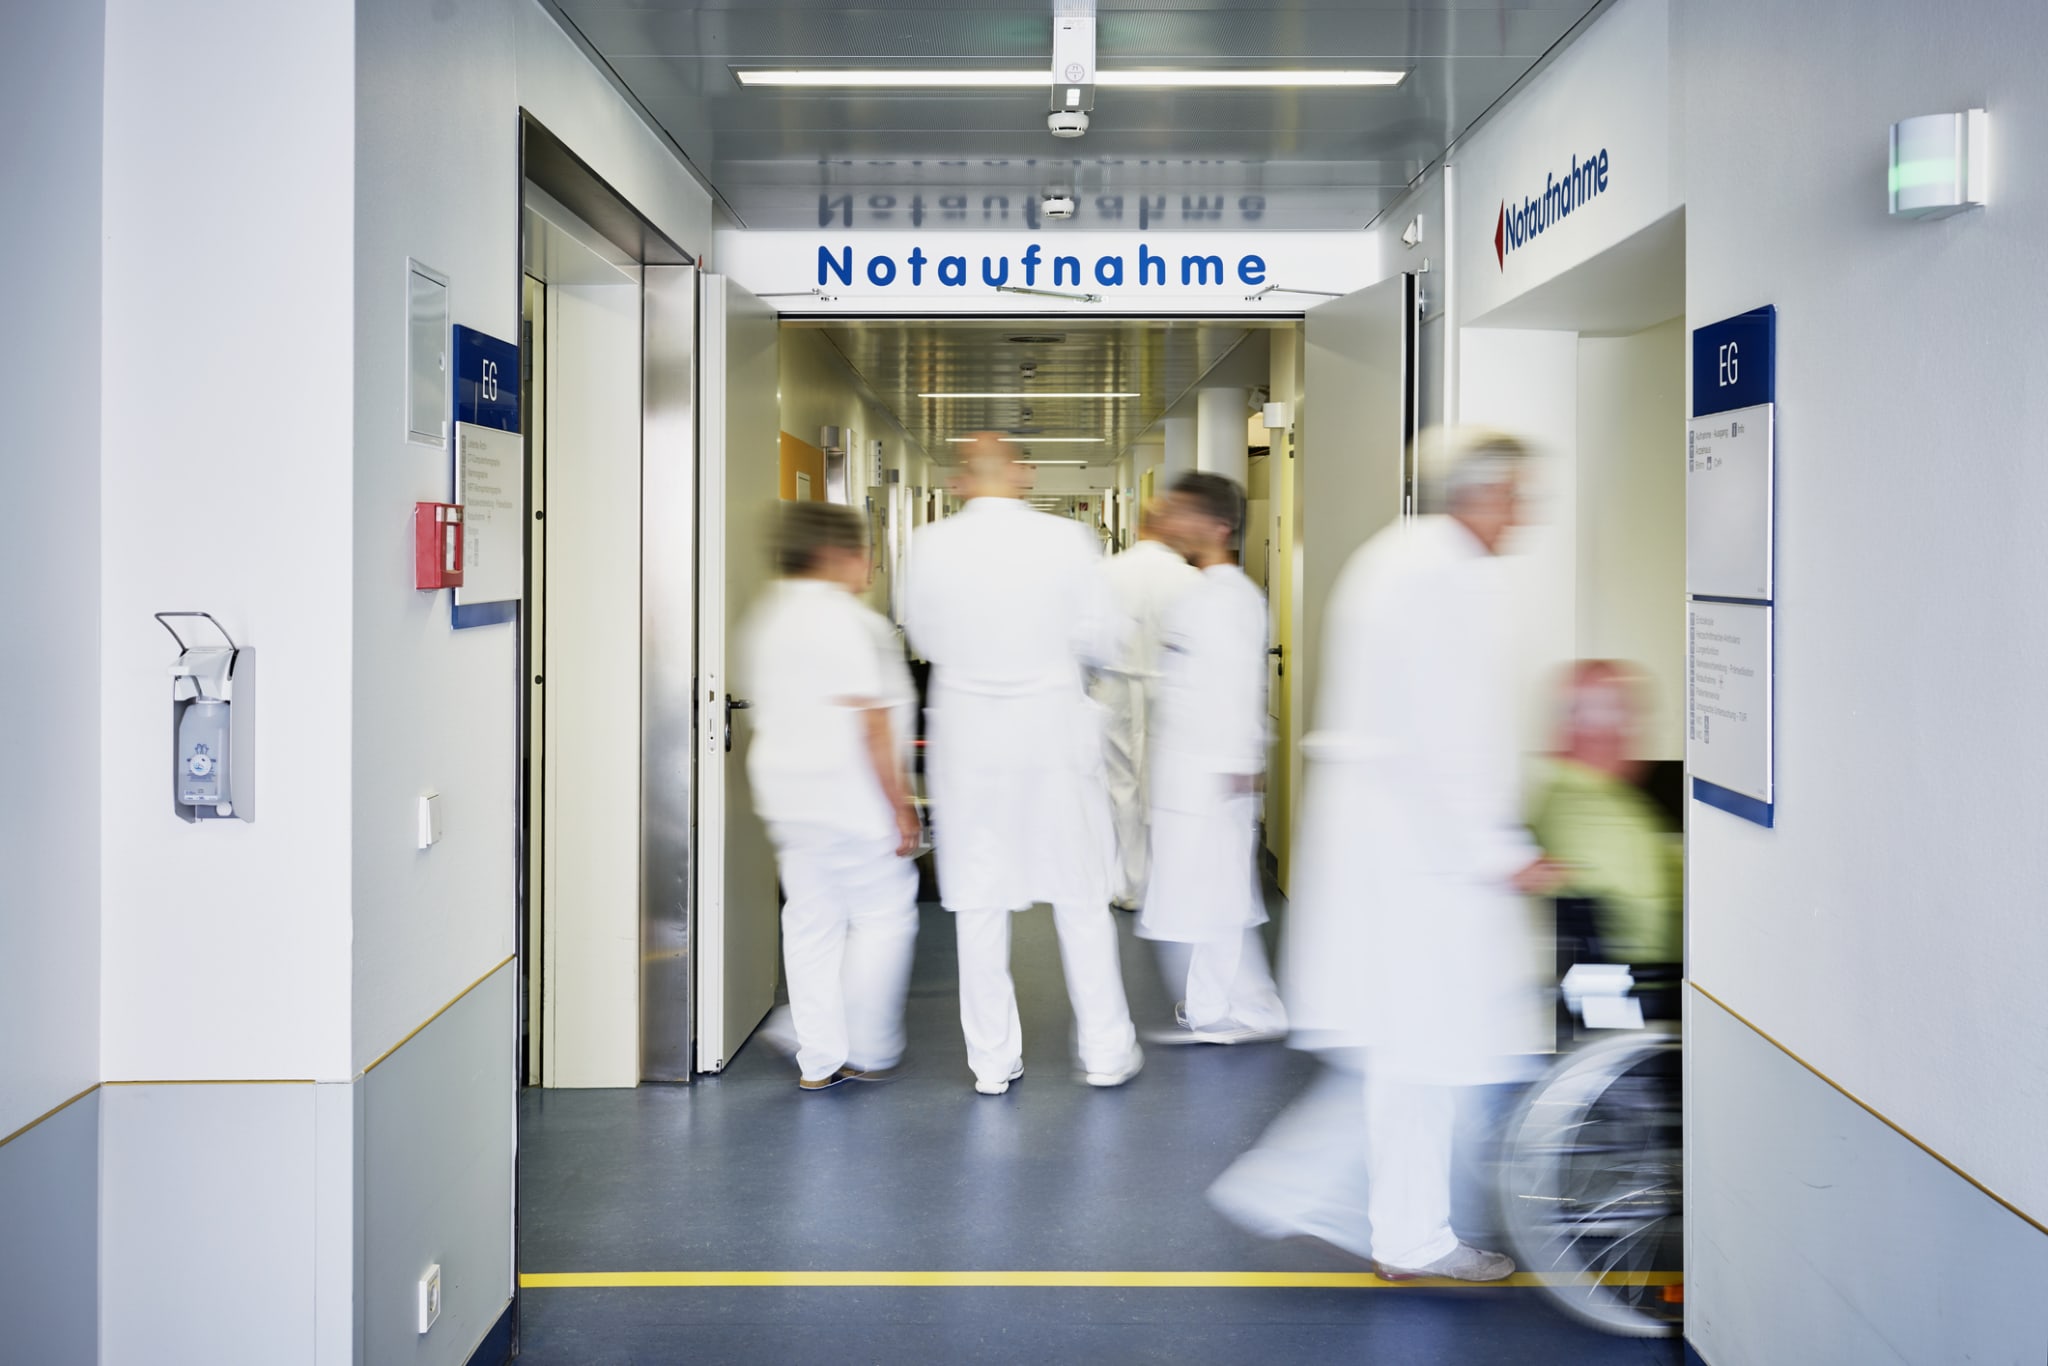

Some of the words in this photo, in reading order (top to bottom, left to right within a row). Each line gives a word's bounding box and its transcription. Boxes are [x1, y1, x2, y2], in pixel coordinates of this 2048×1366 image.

[1504, 148, 1609, 255] Notaufnahme
[817, 243, 1267, 287] Notaufnahme
[482, 358, 498, 402] EG
[1719, 341, 1738, 387] EG
